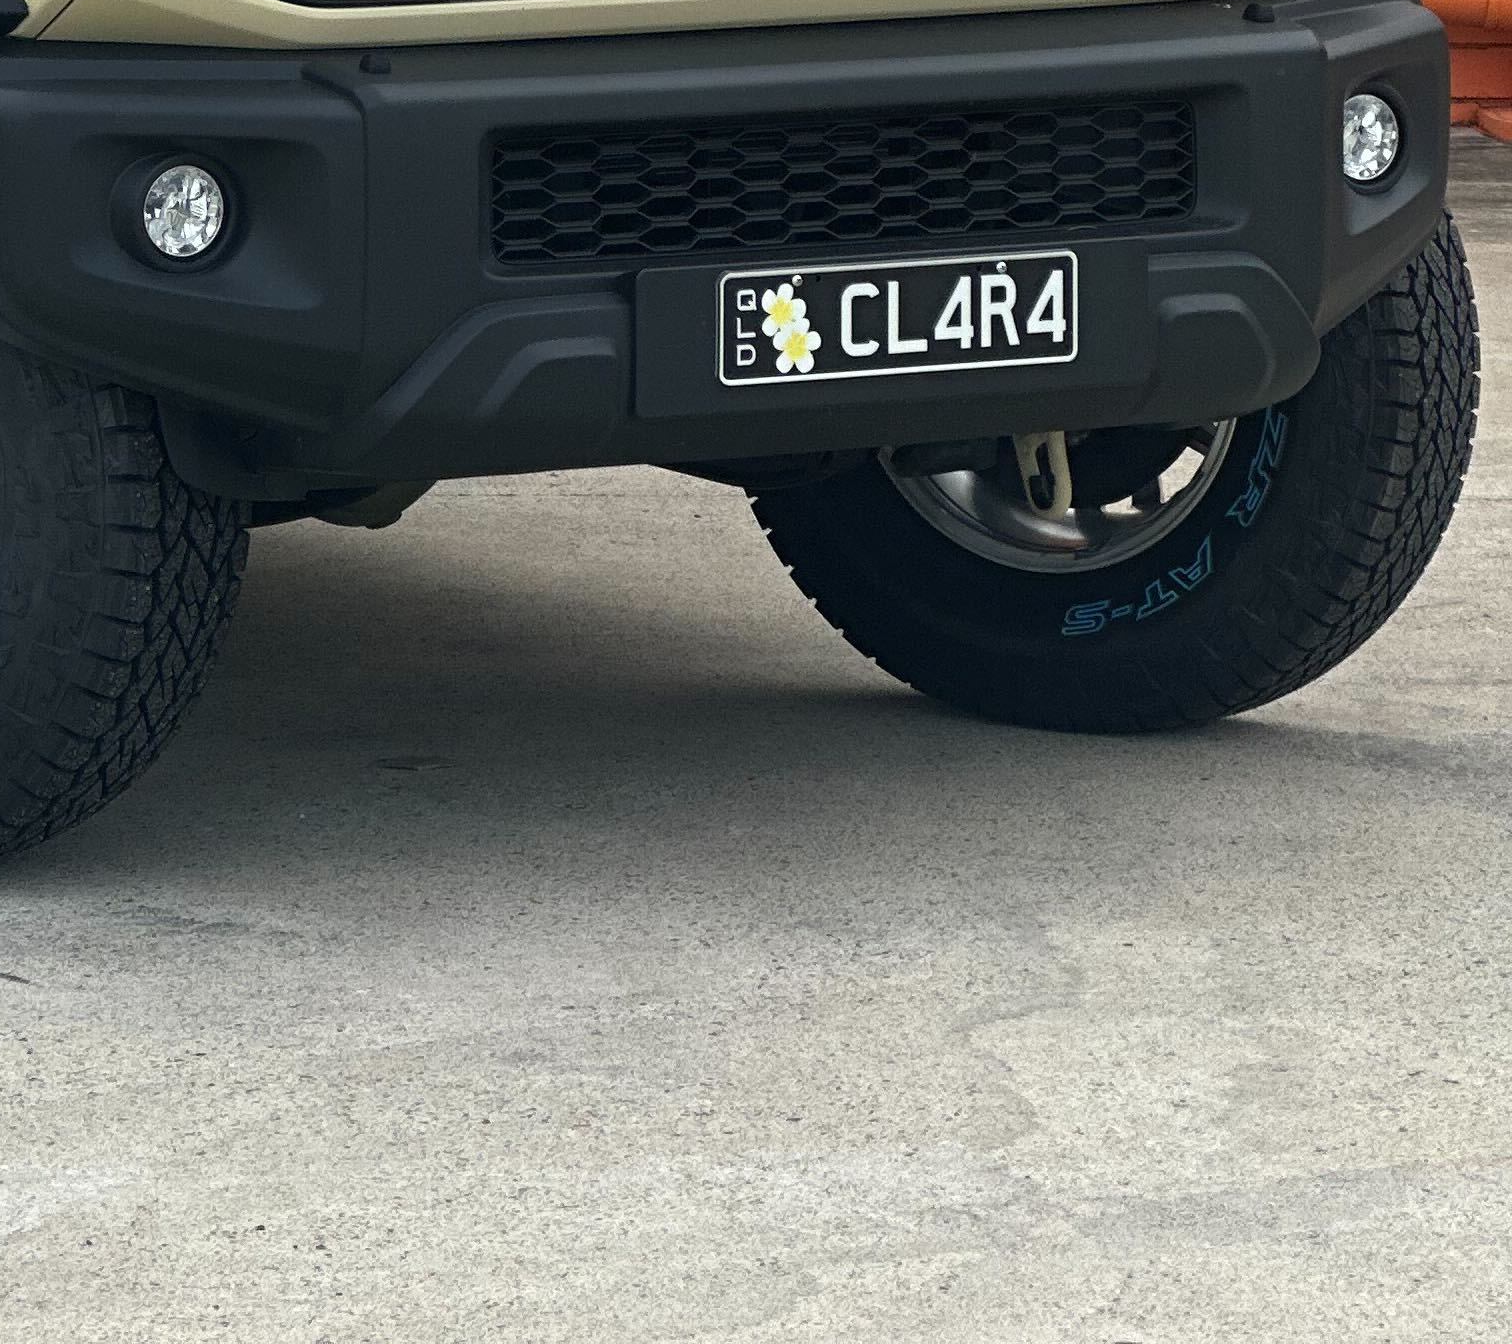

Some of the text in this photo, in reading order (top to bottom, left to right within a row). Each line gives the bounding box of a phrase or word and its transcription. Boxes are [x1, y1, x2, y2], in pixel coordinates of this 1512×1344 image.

[736, 288, 757, 366] QLD
[840, 269, 1068, 358] CL4R4
[1061, 406, 1286, 637] ZR AT-S
